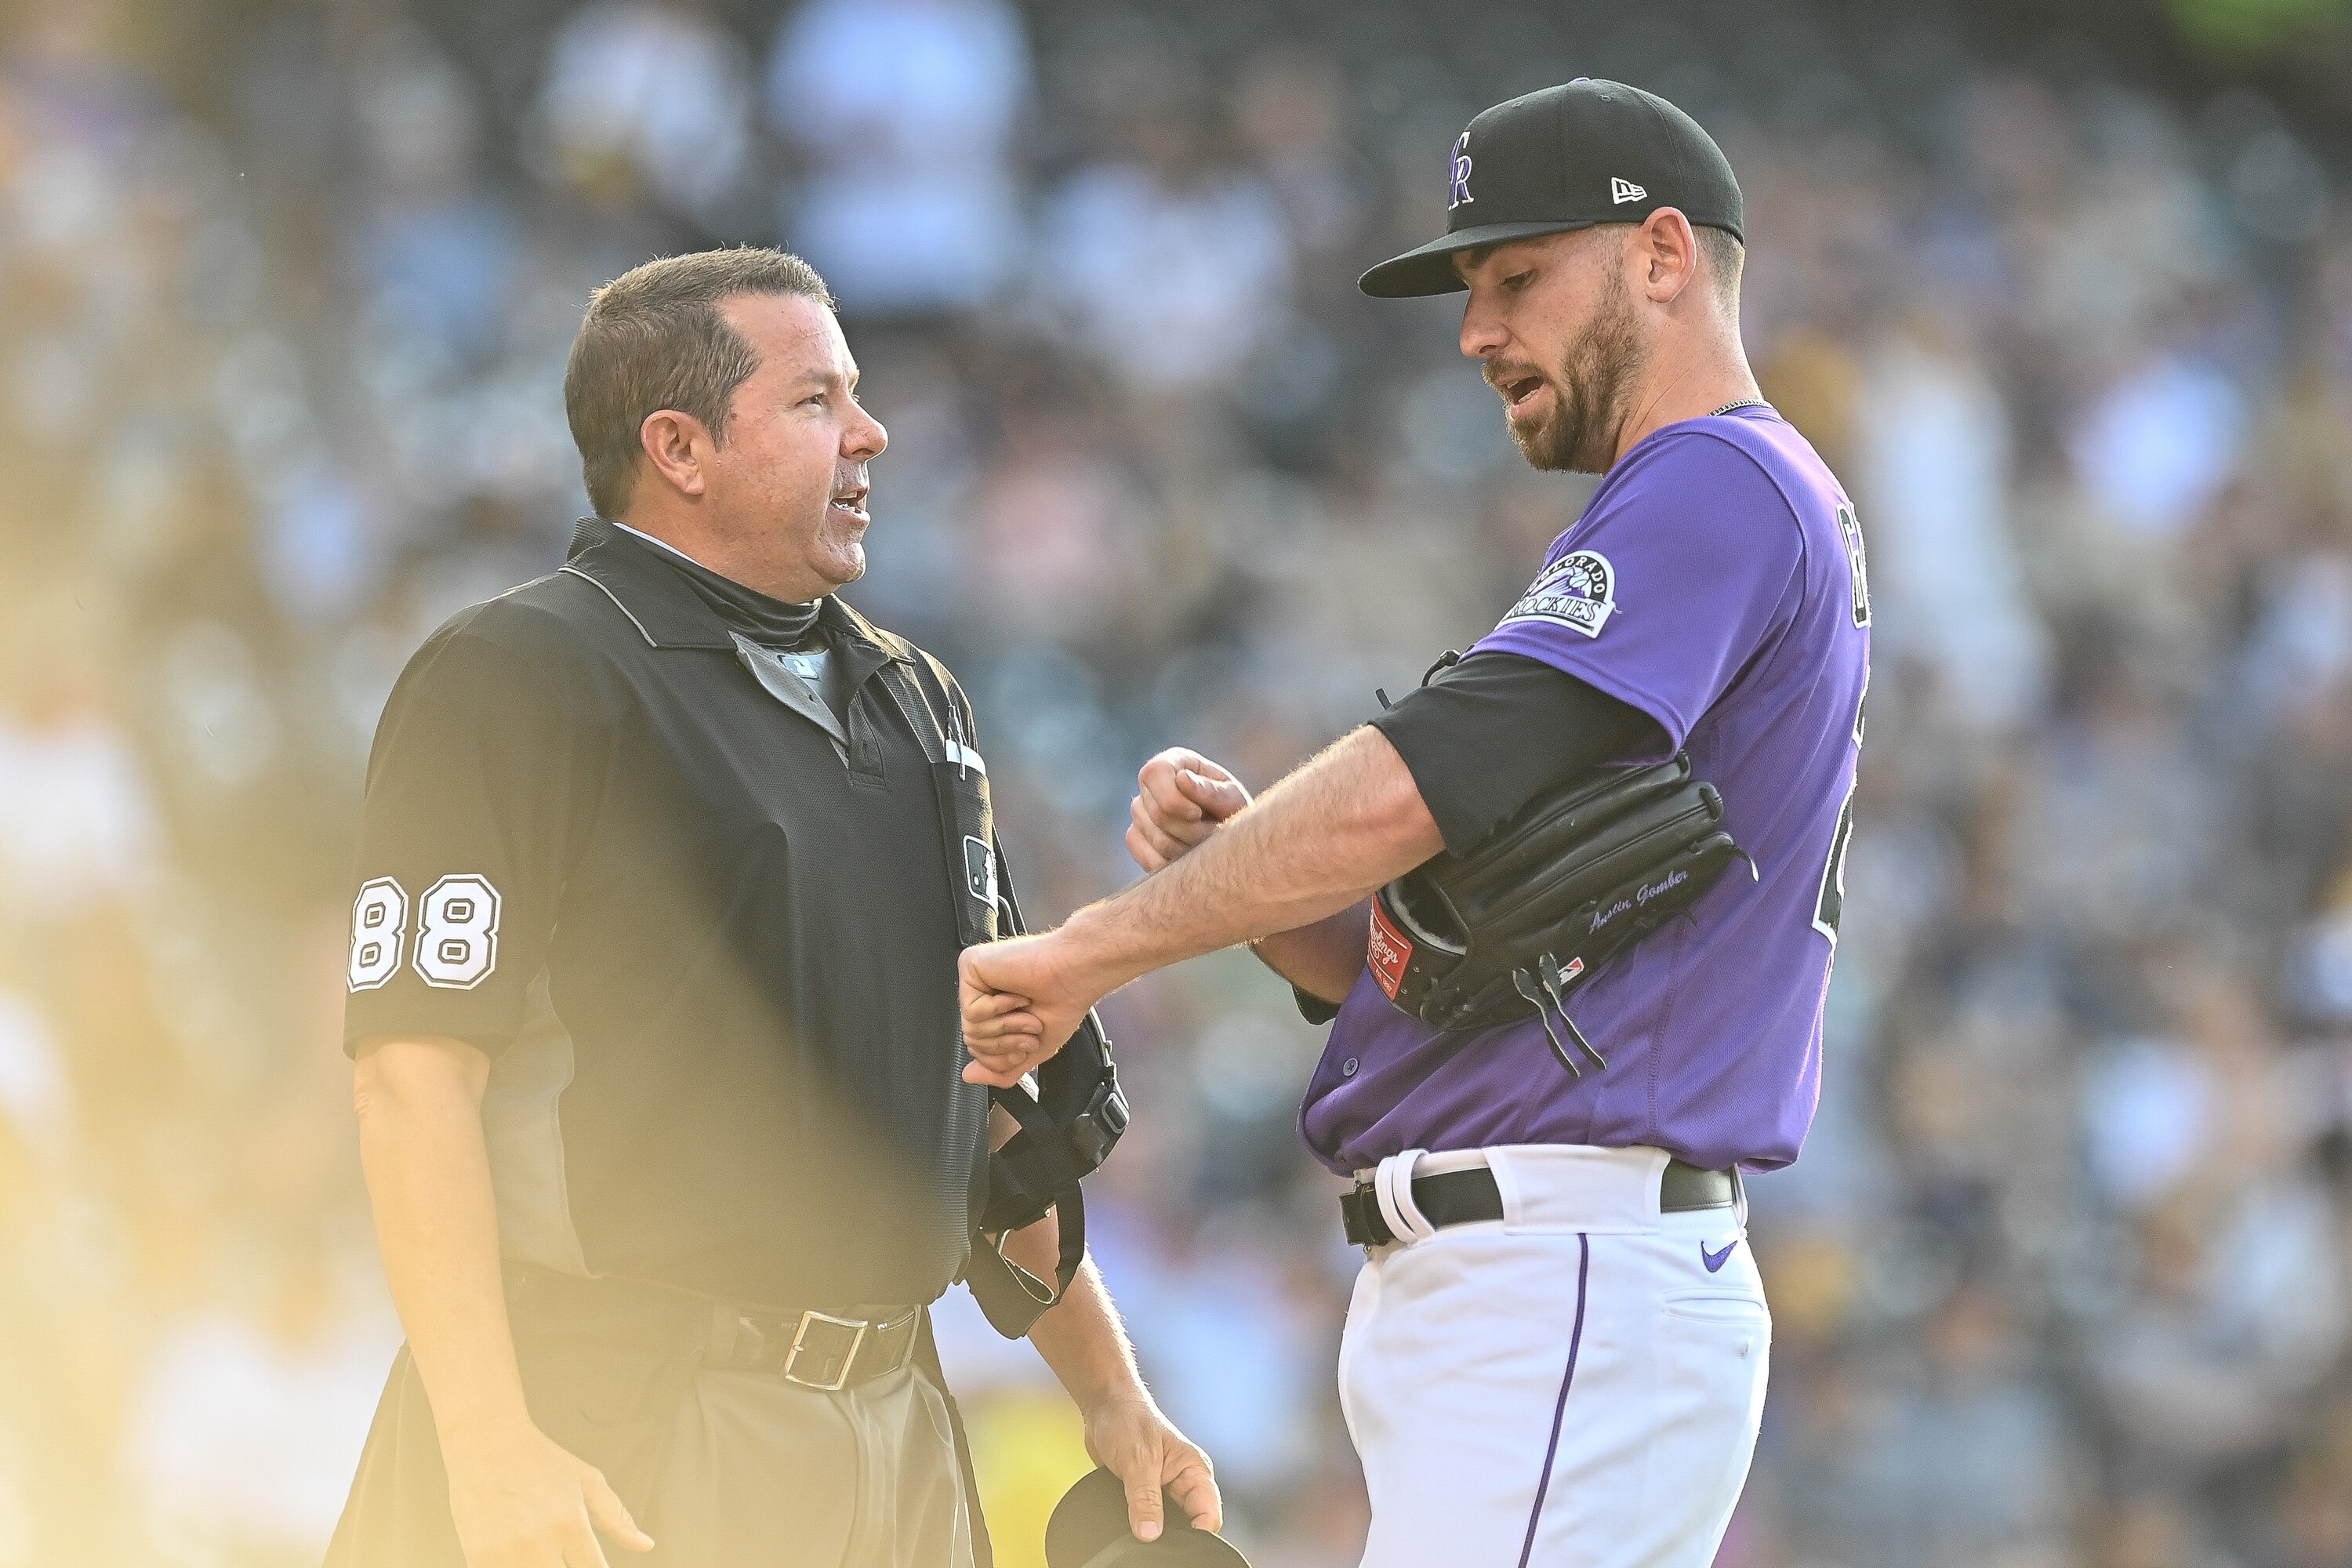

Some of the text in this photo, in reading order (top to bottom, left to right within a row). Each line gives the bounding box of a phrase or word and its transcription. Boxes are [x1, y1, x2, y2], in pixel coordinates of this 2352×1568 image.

[1529, 555, 1606, 594] COLORADO
[1508, 595, 1602, 622] ROCKIES
[1588, 870, 1689, 935] Austin Gomber
[346, 873, 502, 993] 88
